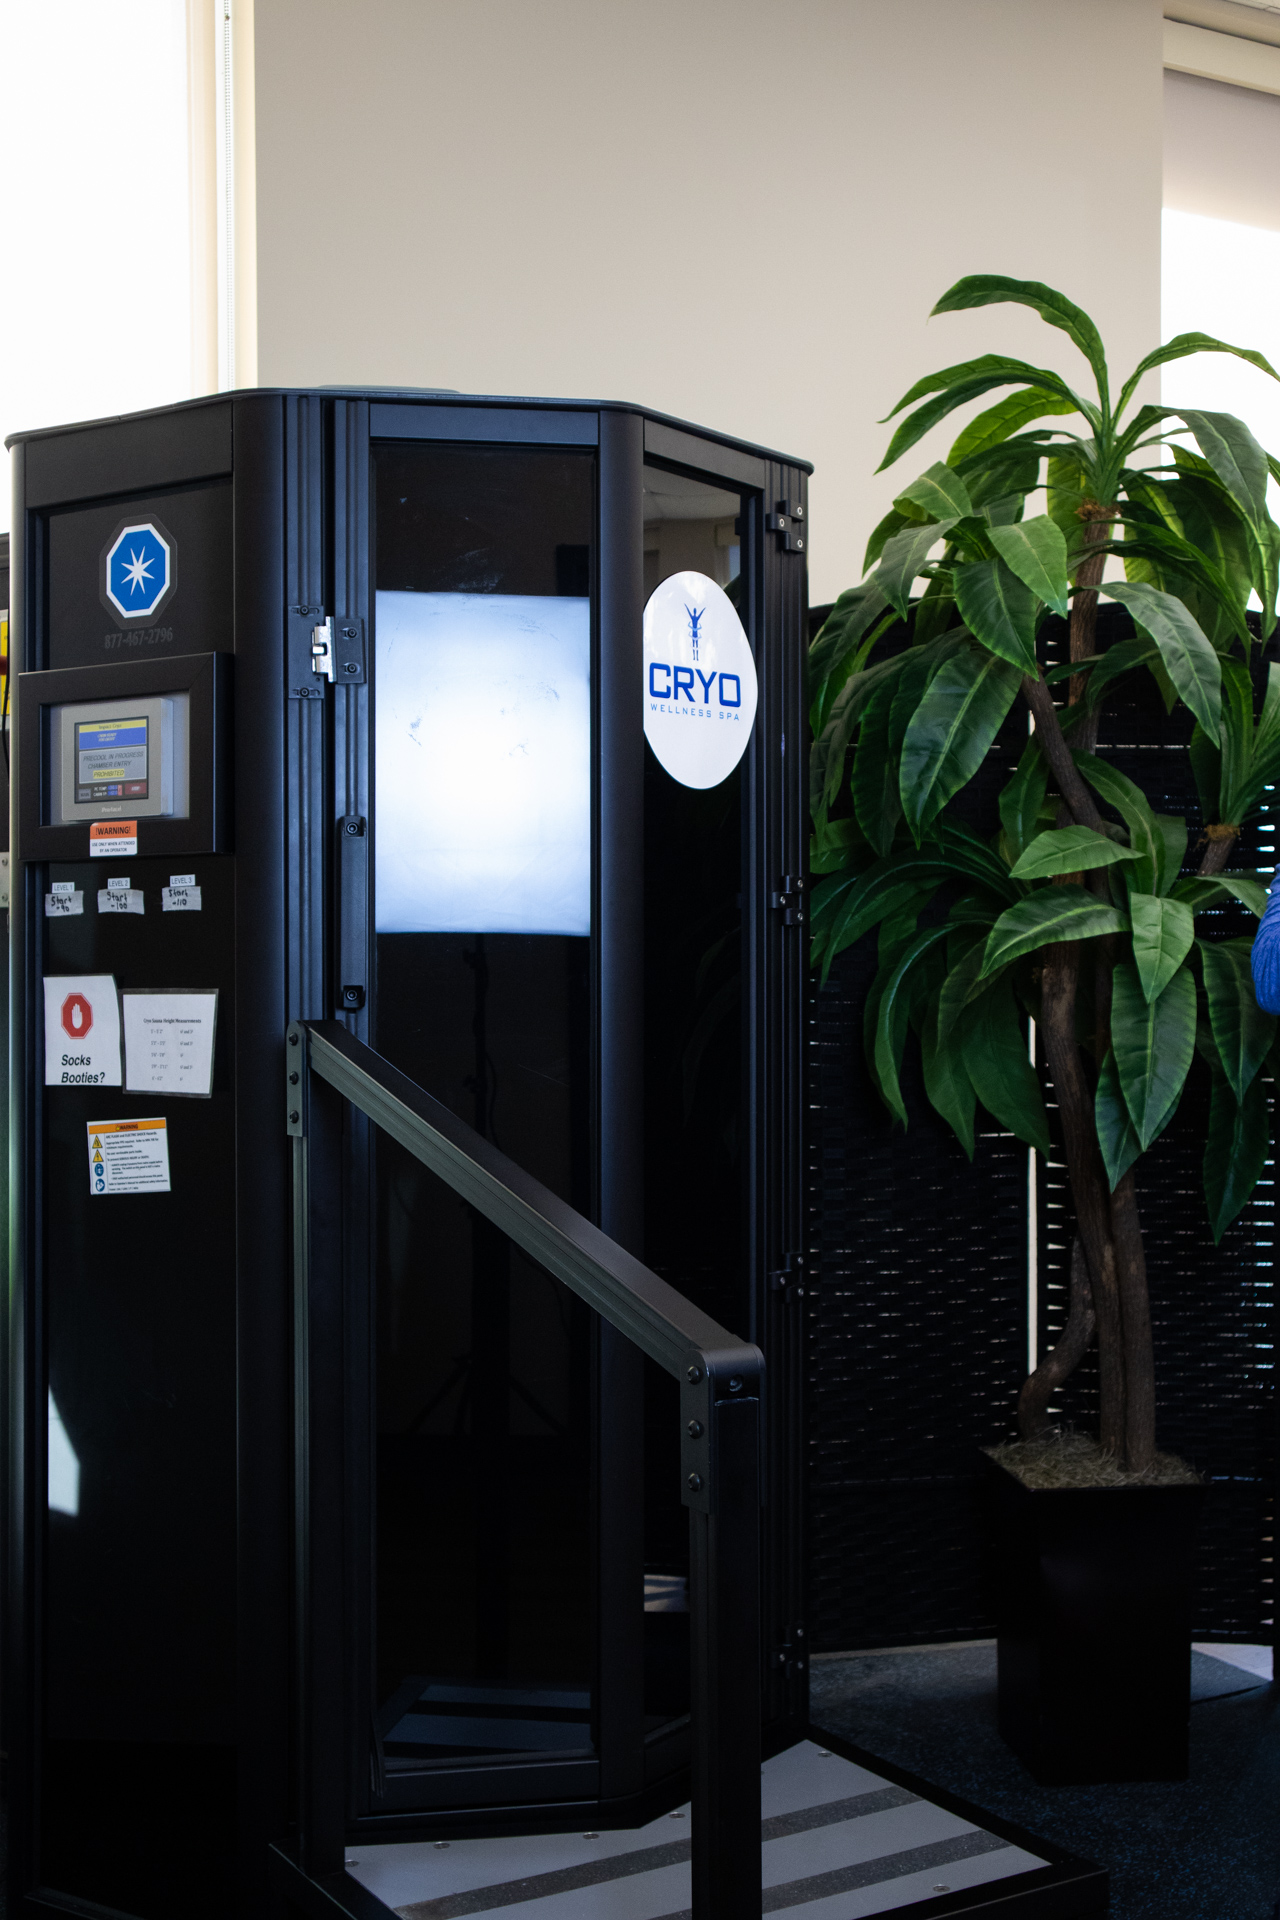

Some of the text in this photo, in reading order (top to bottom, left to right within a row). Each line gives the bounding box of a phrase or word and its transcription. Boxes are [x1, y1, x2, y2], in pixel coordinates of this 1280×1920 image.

[104, 627, 173, 649] 877-467-2796
[649, 662, 741, 708] CRYO
[650, 703, 740, 721] WELLNESS SPA
[115, 751, 144, 759] PROGRESS
[87, 761, 113, 769] CHAMBER
[93, 769, 124, 778] PROHIBITED
[108, 880, 124, 888] LEVEL
[172, 877, 188, 885] LEVEL
[54, 884, 69, 892] LEVEL
[107, 892, 128, 903] Start
[168, 889, 189, 898] Start
[50, 896, 72, 907] Start
[110, 902, 128, 911] -100
[61, 1054, 91, 1066] Socks
[61, 1071, 106, 1084] Booties?
